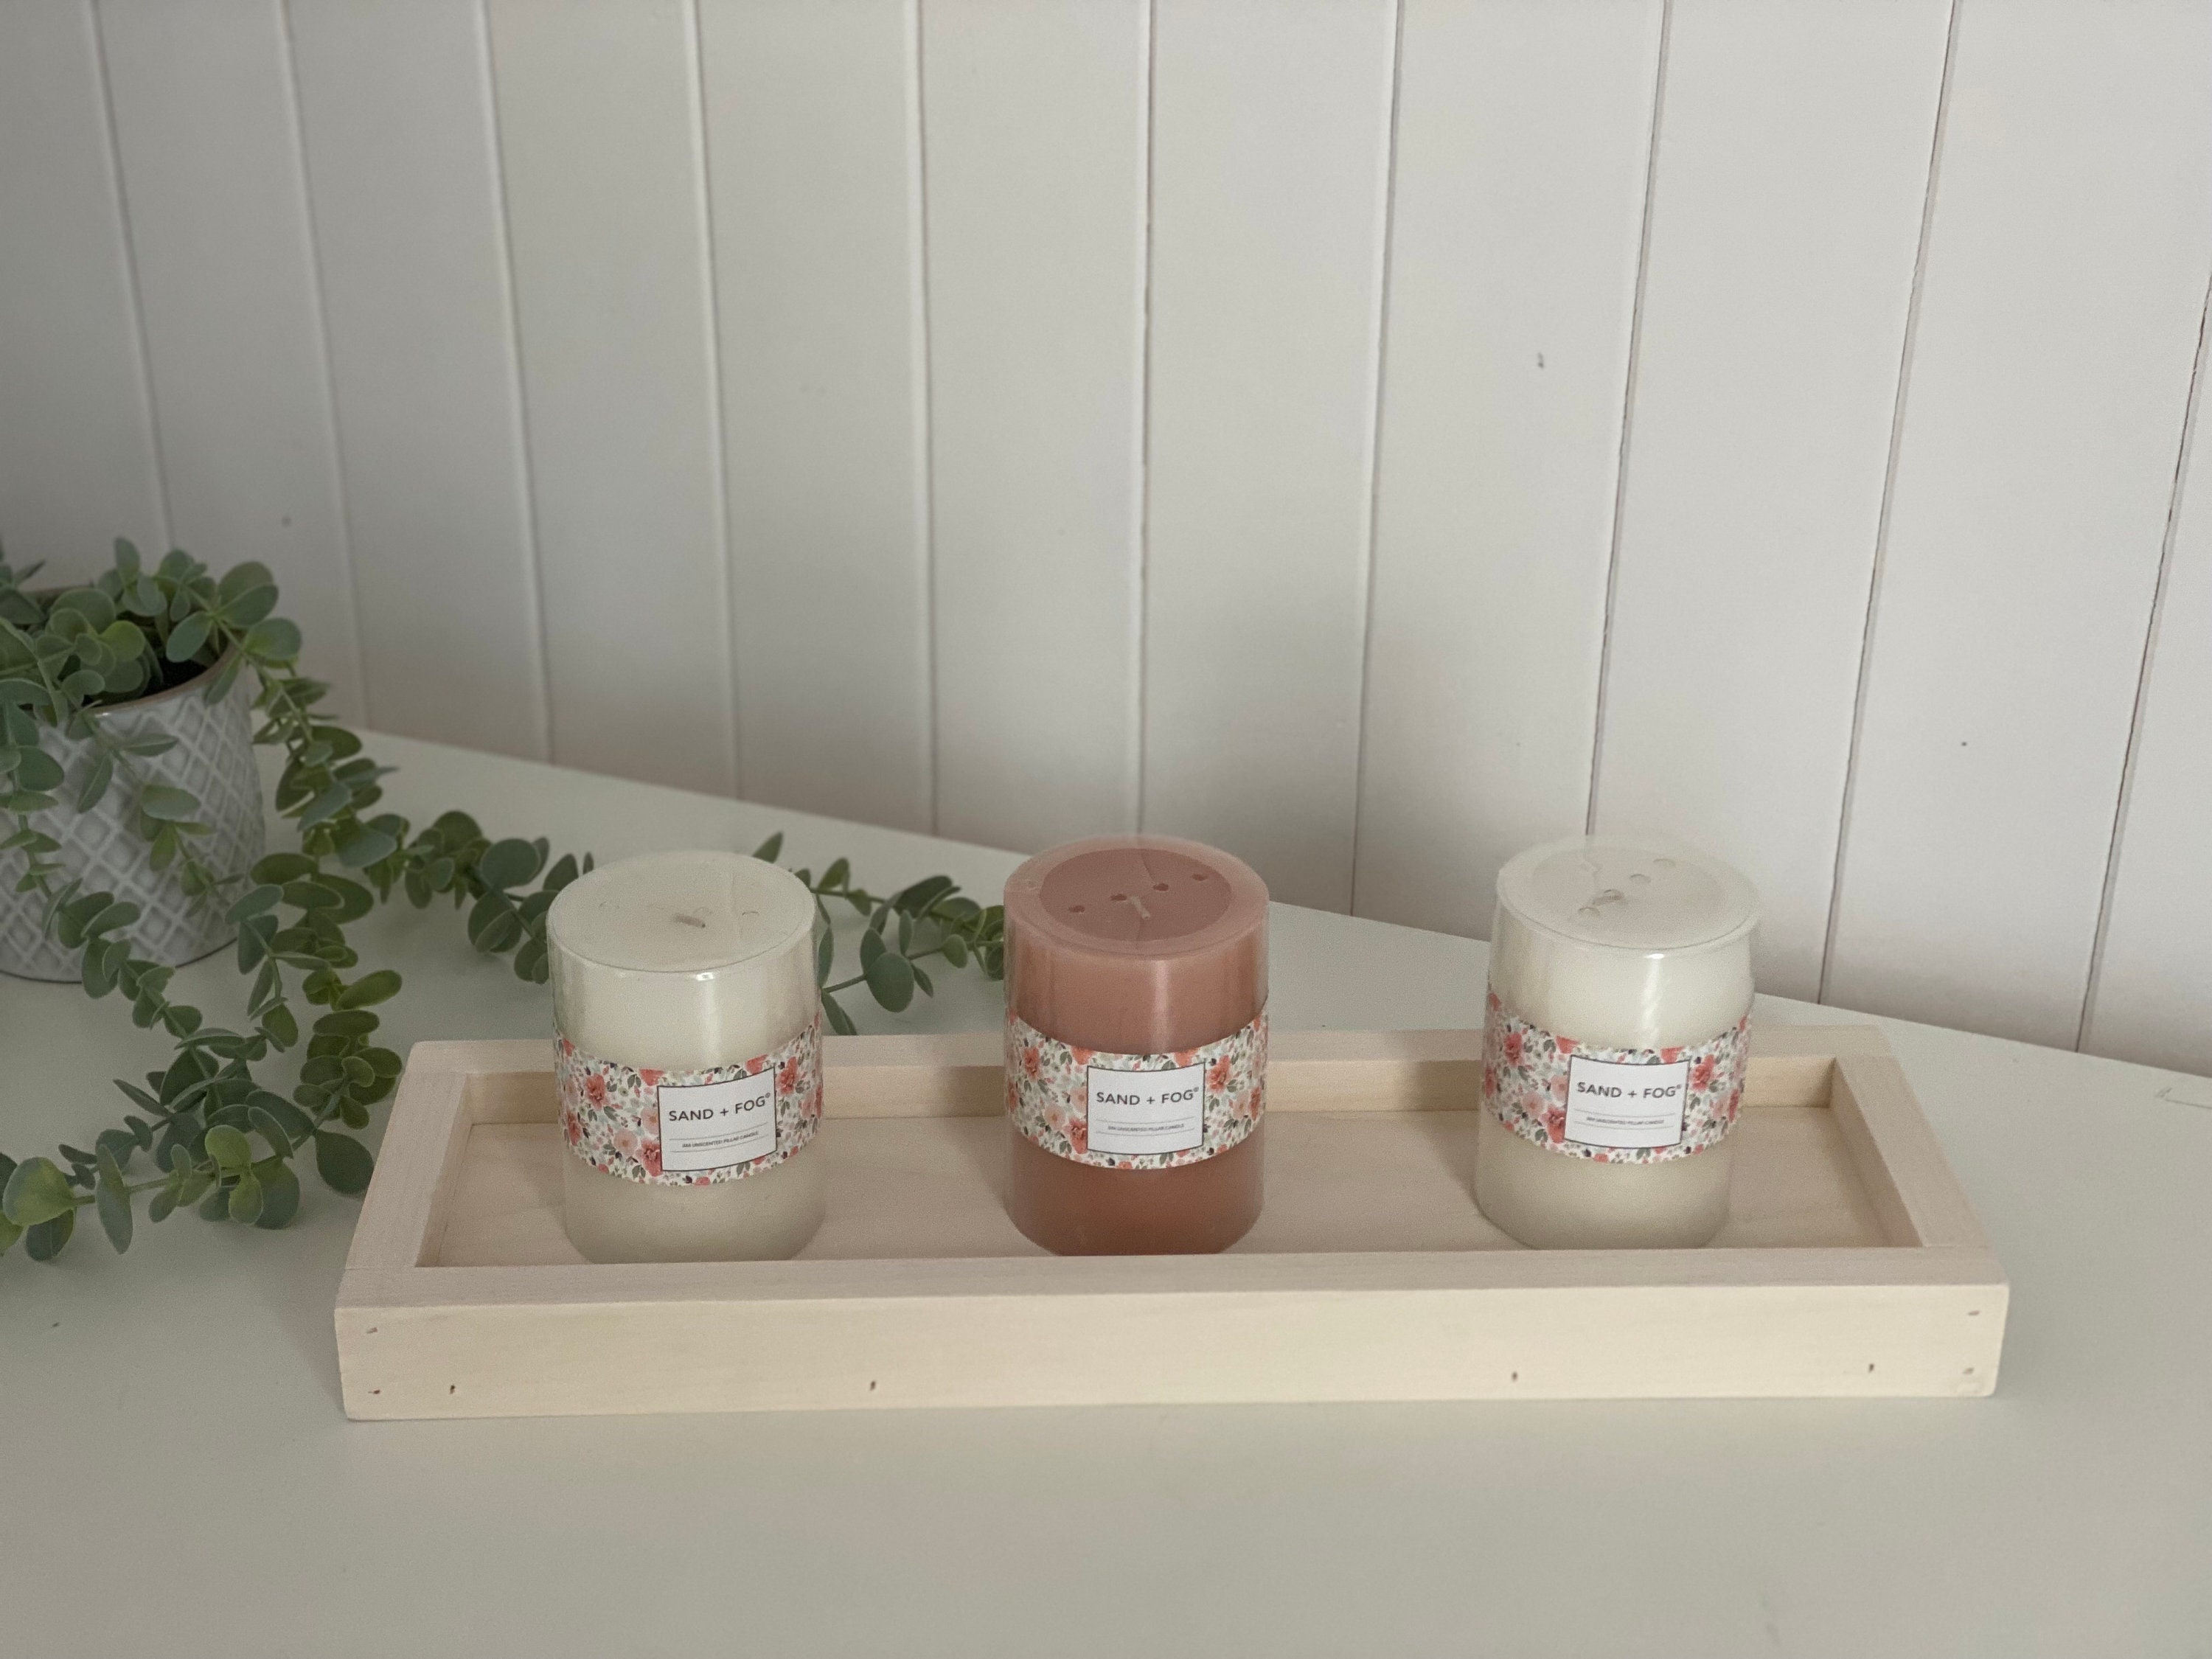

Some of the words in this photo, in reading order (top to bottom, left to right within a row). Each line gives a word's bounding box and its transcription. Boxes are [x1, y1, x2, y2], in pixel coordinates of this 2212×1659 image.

[1577, 1082, 1622, 1098] SAND
[1096, 1091, 1140, 1105] SAND
[669, 1109, 714, 1121] SAND
